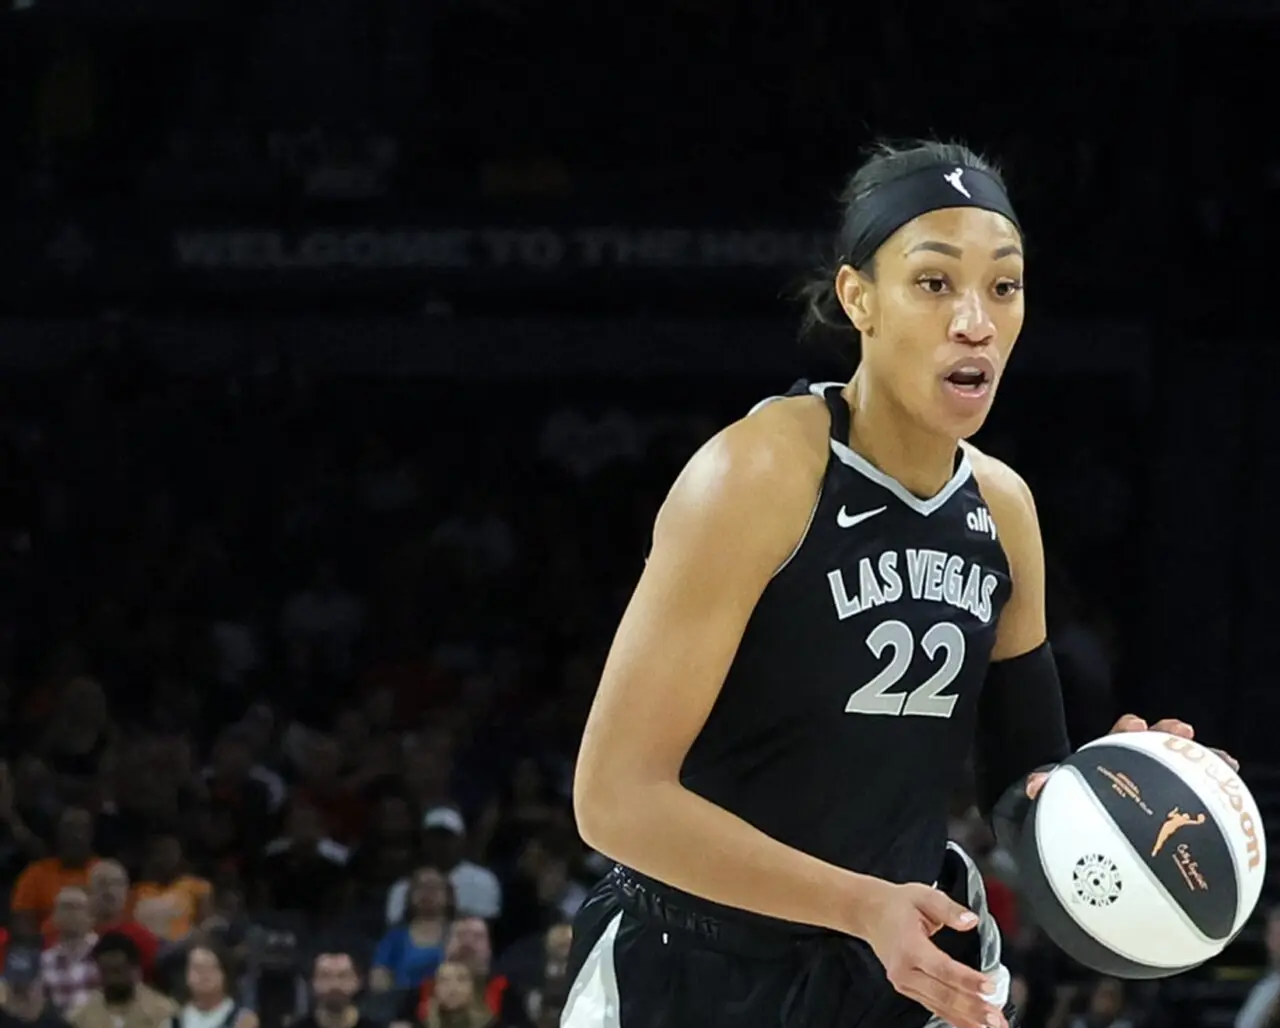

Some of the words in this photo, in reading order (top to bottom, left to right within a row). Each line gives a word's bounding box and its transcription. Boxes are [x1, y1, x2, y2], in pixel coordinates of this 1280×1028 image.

[174, 229, 472, 267] WELCOME
[482, 229, 564, 267] TO
[573, 229, 690, 267] THE
[966, 507, 996, 541] ally
[827, 551, 903, 621] LAS
[906, 549, 998, 623] VEGAS
[845, 620, 966, 718] 22
